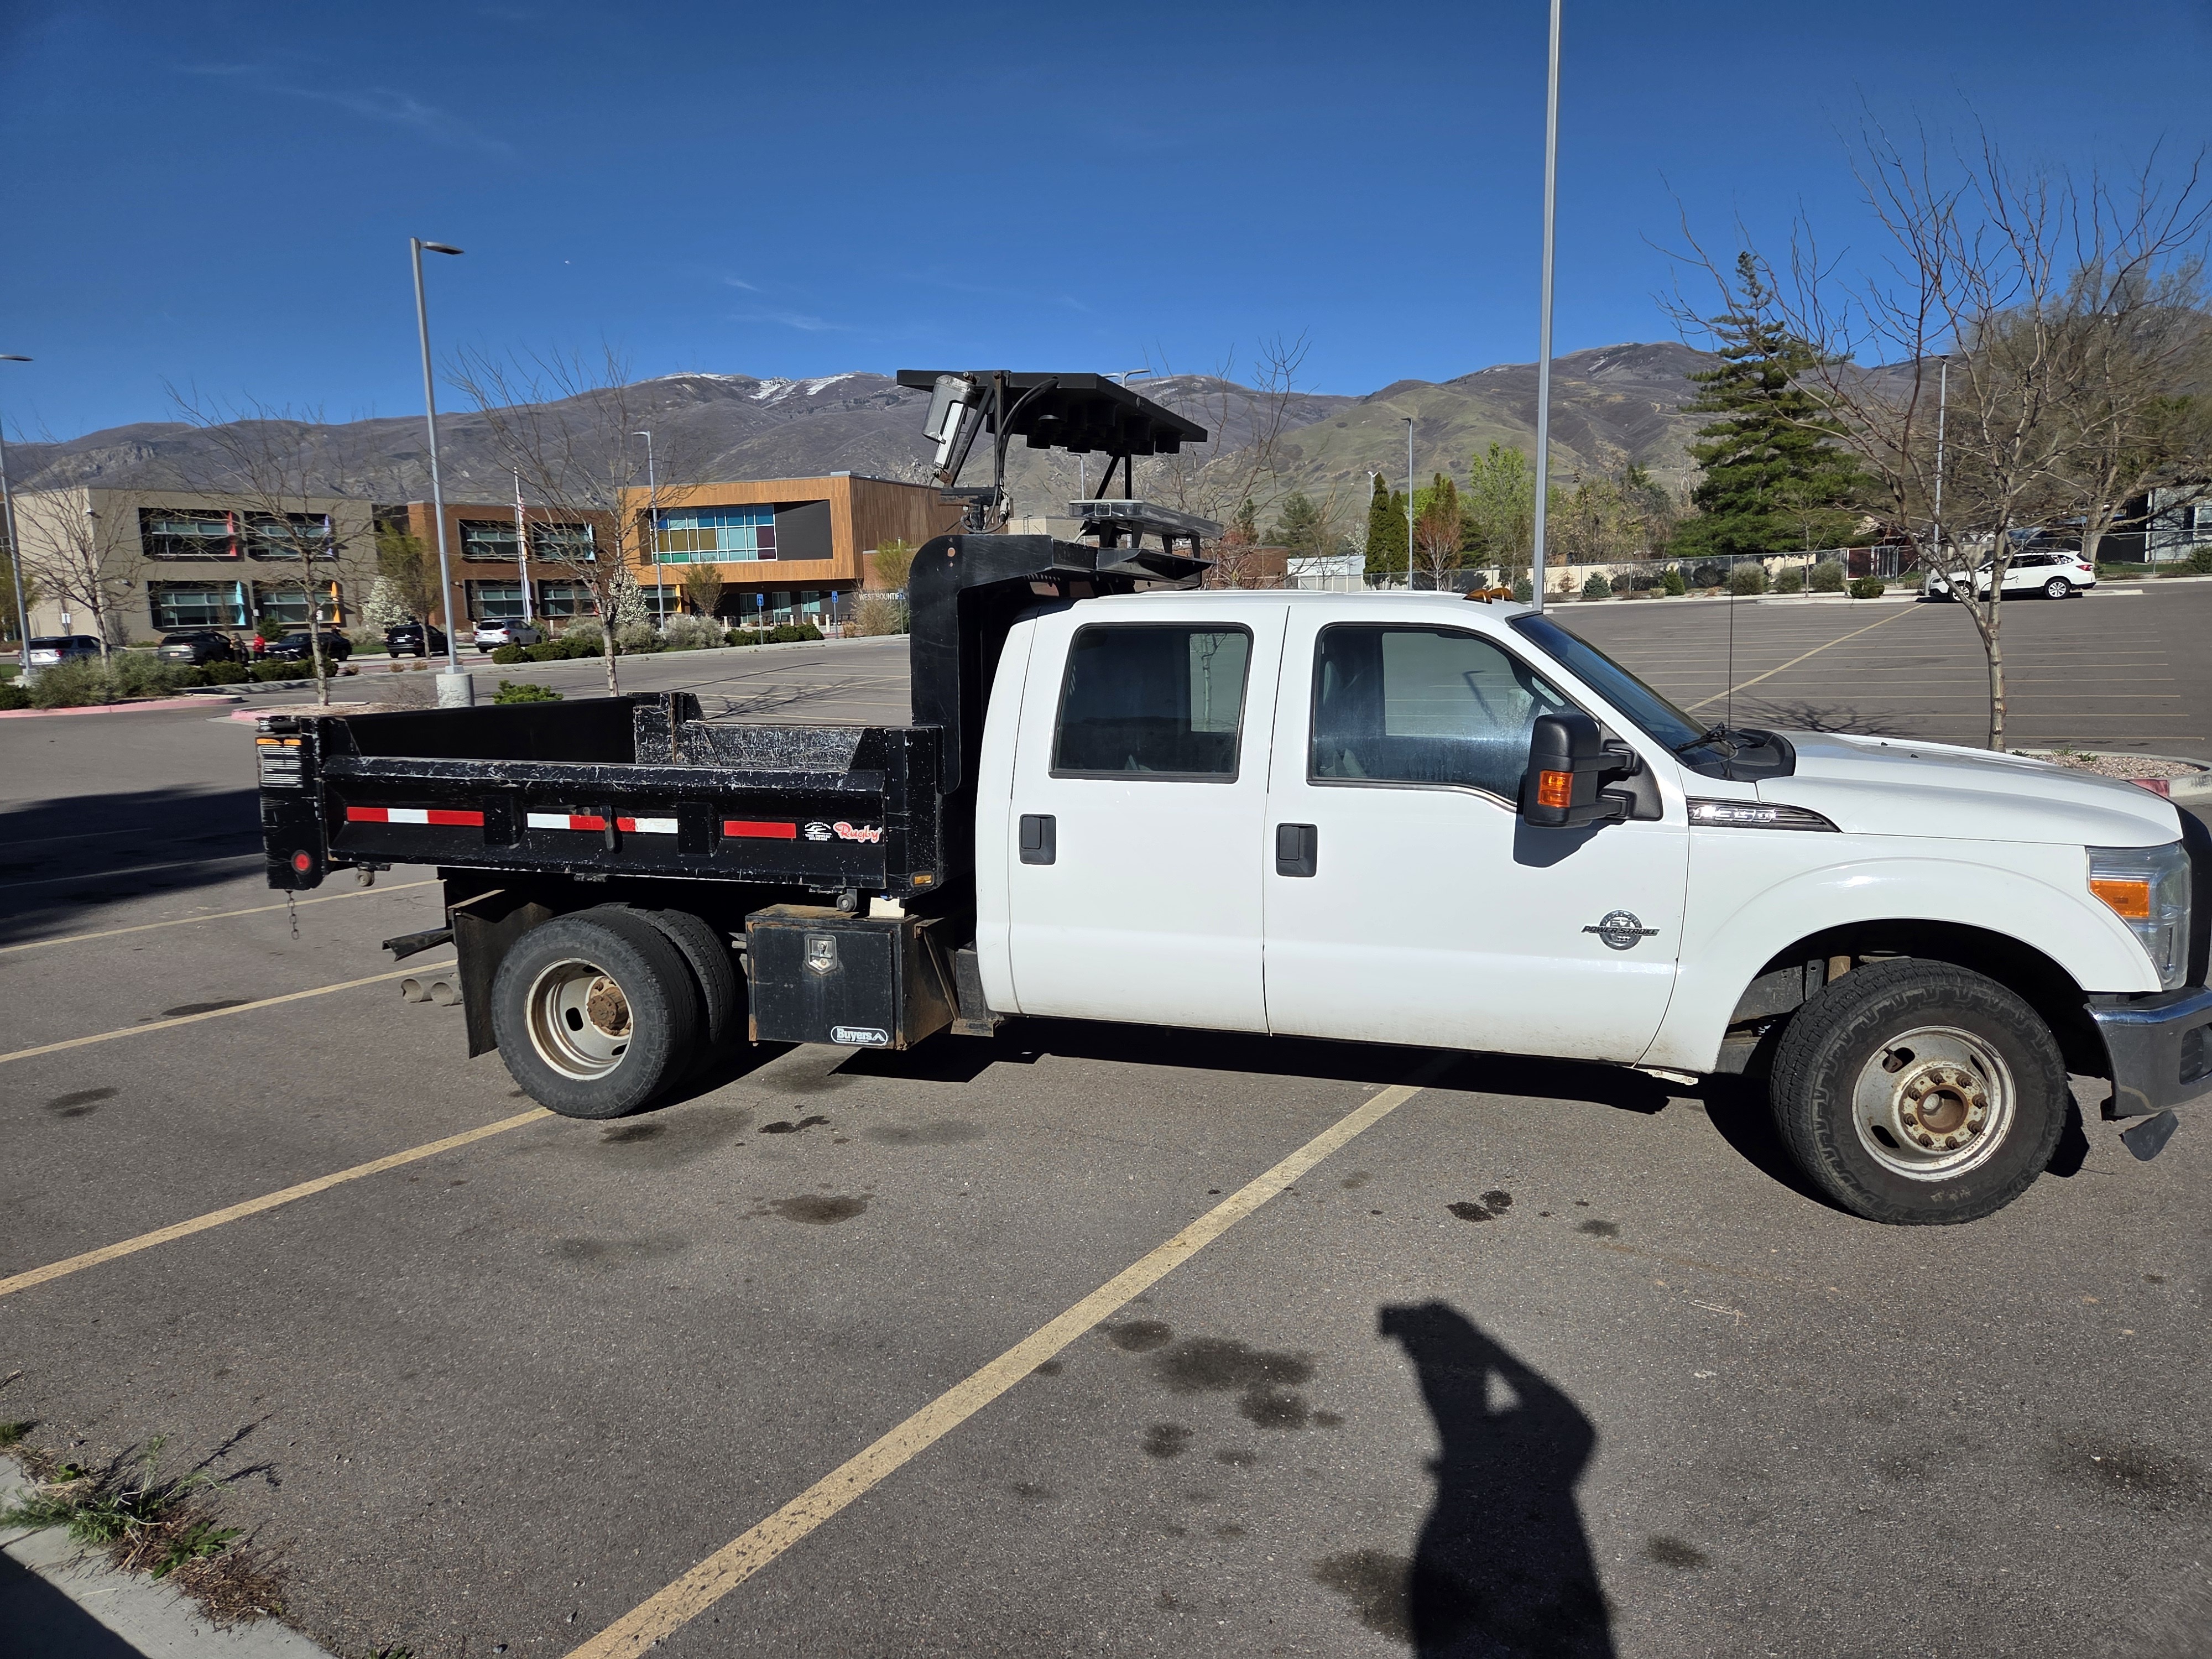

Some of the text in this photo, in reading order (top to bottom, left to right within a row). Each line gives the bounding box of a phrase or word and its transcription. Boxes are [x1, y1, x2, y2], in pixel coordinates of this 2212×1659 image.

[834, 822, 879, 841] Rugby
[1581, 925, 1661, 936] POWER STROKE
[837, 1027, 873, 1042] Buyers
